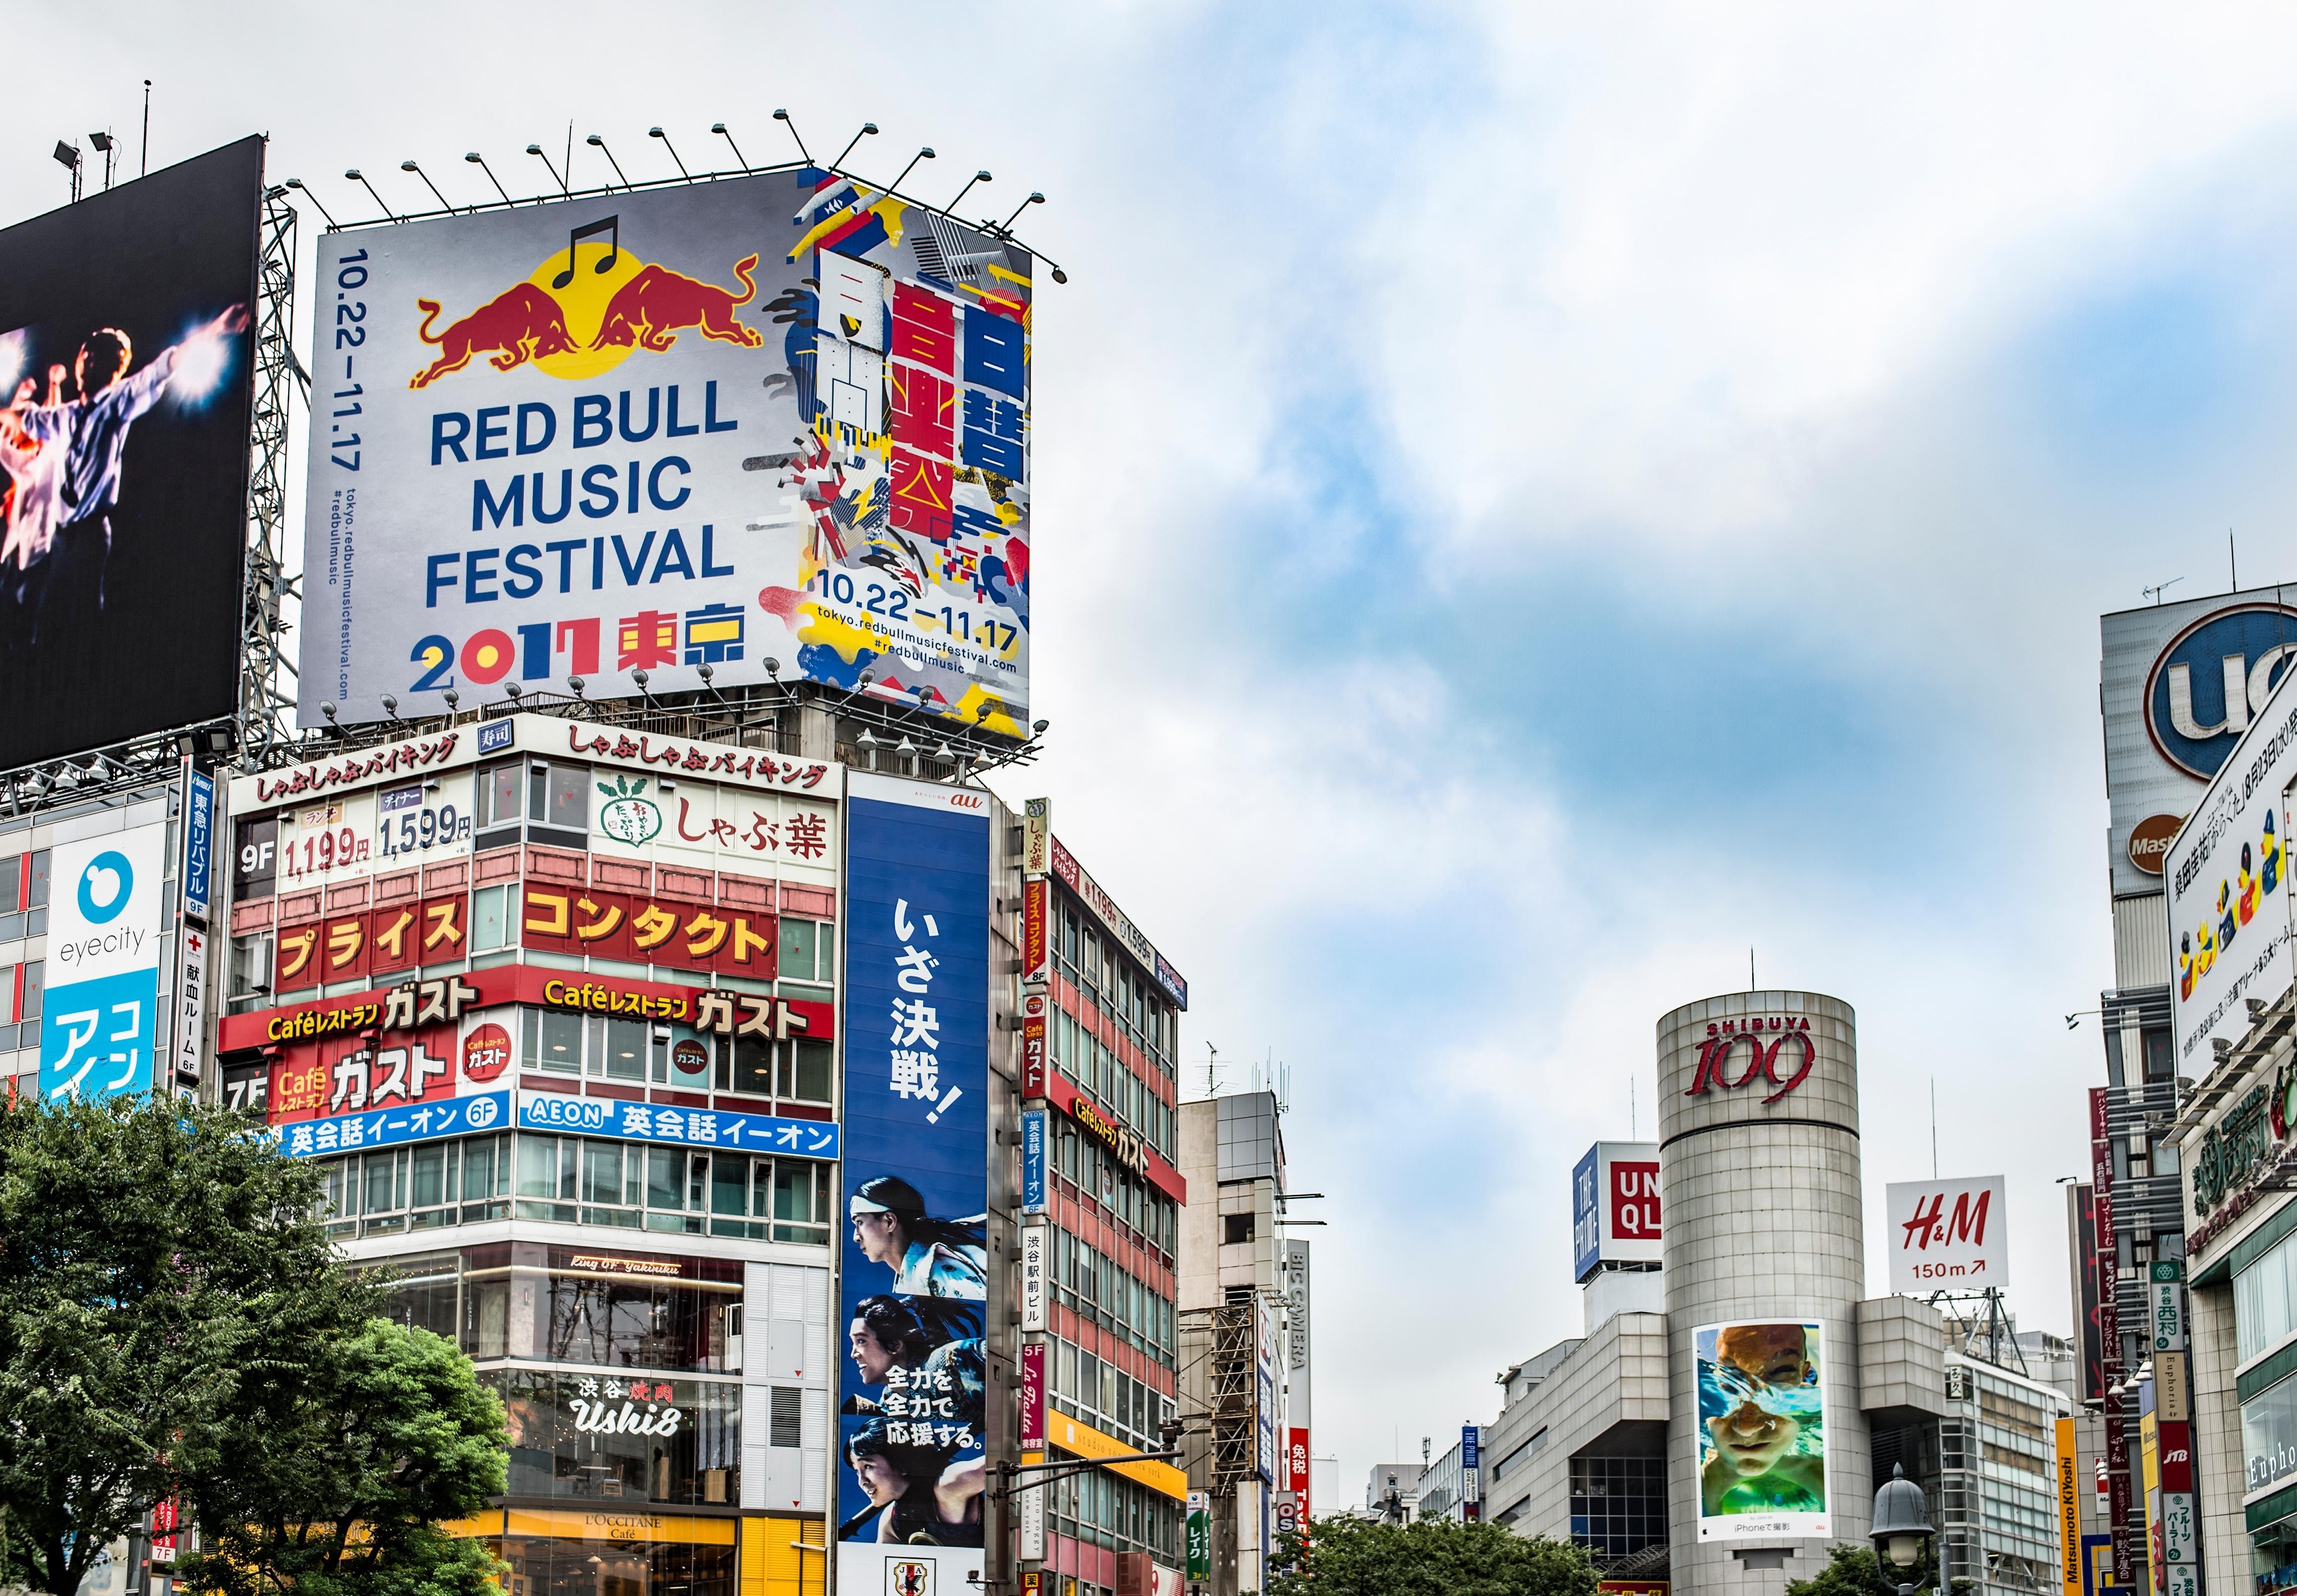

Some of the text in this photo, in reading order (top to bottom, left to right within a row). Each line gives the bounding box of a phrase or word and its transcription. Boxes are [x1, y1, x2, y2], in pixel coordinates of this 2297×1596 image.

[431, 381, 738, 466] RED BULL
[472, 455, 691, 532] MUSIC
[329, 489, 342, 585] #redbullmusic
[426, 524, 735, 609] FESTIVAL
[339, 487, 356, 701] tokyo.redbullmusicfestival.com
[409, 602, 746, 693] 2017 東京
[817, 604, 1016, 674] tokyo.redbullmusicfestival.com
[874, 639, 965, 674] #redbullmusic
[480, 723, 510, 749] 寿司
[257, 732, 459, 802] しゃぶしゃぶバイキング
[569, 724, 828, 788] しゃぶしゃぶバイキング
[305, 804, 339, 827] ランチ
[384, 792, 421, 811] ディナー
[950, 793, 983, 808] au
[190, 792, 208, 895] 東急リバブル
[380, 804, 471, 862] 1,599円
[678, 796, 827, 860] しゃぶ葉
[1029, 819, 1043, 871] しゃぶ葉
[241, 840, 275, 874] 9F
[285, 827, 370, 883] 1,199円
[190, 901, 203, 914] 9F
[1030, 883, 1040, 968] プライス コンタクト
[60, 926, 145, 967] eyecity
[280, 892, 768, 977] プライス コンタクト
[1032, 971, 1045, 981] 8F
[183, 963, 200, 1056] 献血ルーム
[267, 976, 476, 1041] Caféレストラン ガスト
[544, 980, 809, 1041] Caféレストラン ガスト
[1707, 1017, 1810, 1036] SHIBUYA
[1026, 1025, 1043, 1033] Café
[183, 1059, 195, 1072] 6F
[468, 1048, 507, 1069] ガスト
[677, 1053, 704, 1066] ガスト
[1027, 1038, 1042, 1088] ガスト
[1684, 1031, 1816, 1104] 109
[227, 1077, 268, 1111] 7F
[278, 1065, 326, 1095] Café
[331, 1046, 446, 1112] ガスト
[278, 1092, 325, 1113] レストラン
[291, 1107, 457, 1155] 英会話イーオン
[469, 1102, 494, 1122] 6F
[530, 1100, 832, 1151] AEON 英会話イーオン
[1028, 1121, 1040, 1204] 英会話イーオン
[1117, 1127, 1149, 1176] ガスト
[1579, 1165, 1592, 1216] THE
[1028, 1205, 1039, 1214] 6F
[1902, 1189, 1991, 1251] H&M
[1575, 1206, 1598, 1266] PRIME
[570, 1255, 679, 1275] King Yakiniku
[1027, 1236, 1040, 1322] 渋谷駅前ビル
[1912, 1263, 1965, 1279] 150m
[1290, 1252, 1306, 1370] BIC CAMERA
[1024, 1345, 1043, 1357] 5F
[578, 1378, 674, 1404] 渋谷 焼肉
[885, 1365, 953, 1391] 全力を
[2165, 1357, 2178, 1409] Euphoria
[885, 1392, 954, 1419] 全力で
[1023, 1362, 1037, 1434] La Fiesta
[569, 1398, 683, 1438] Ushi8
[886, 1421, 982, 1450] 応援する。
[1022, 1438, 1043, 1449] 美容室
[1292, 1444, 1306, 1475] 免税
[1465, 1432, 1476, 1466] THE PRIME
[2163, 1449, 2189, 1464] JTB
[611, 1527, 636, 1540] Café
[1279, 1505, 1294, 1531] OS
[1734, 1522, 1790, 1533] iPhoneで撮影
[2061, 1457, 2078, 1584] Matsumoto KiYoshi
[2180, 1507, 2191, 1542] フルーツ
[157, 1548, 171, 1559] 7F
[1189, 1526, 1200, 1559] レイク
[2115, 1539, 2131, 1579] 餃子屋台
[2170, 1551, 2179, 1559] 2F
[899, 1565, 922, 1575] JFA
[1026, 1574, 1037, 1586] 薬
